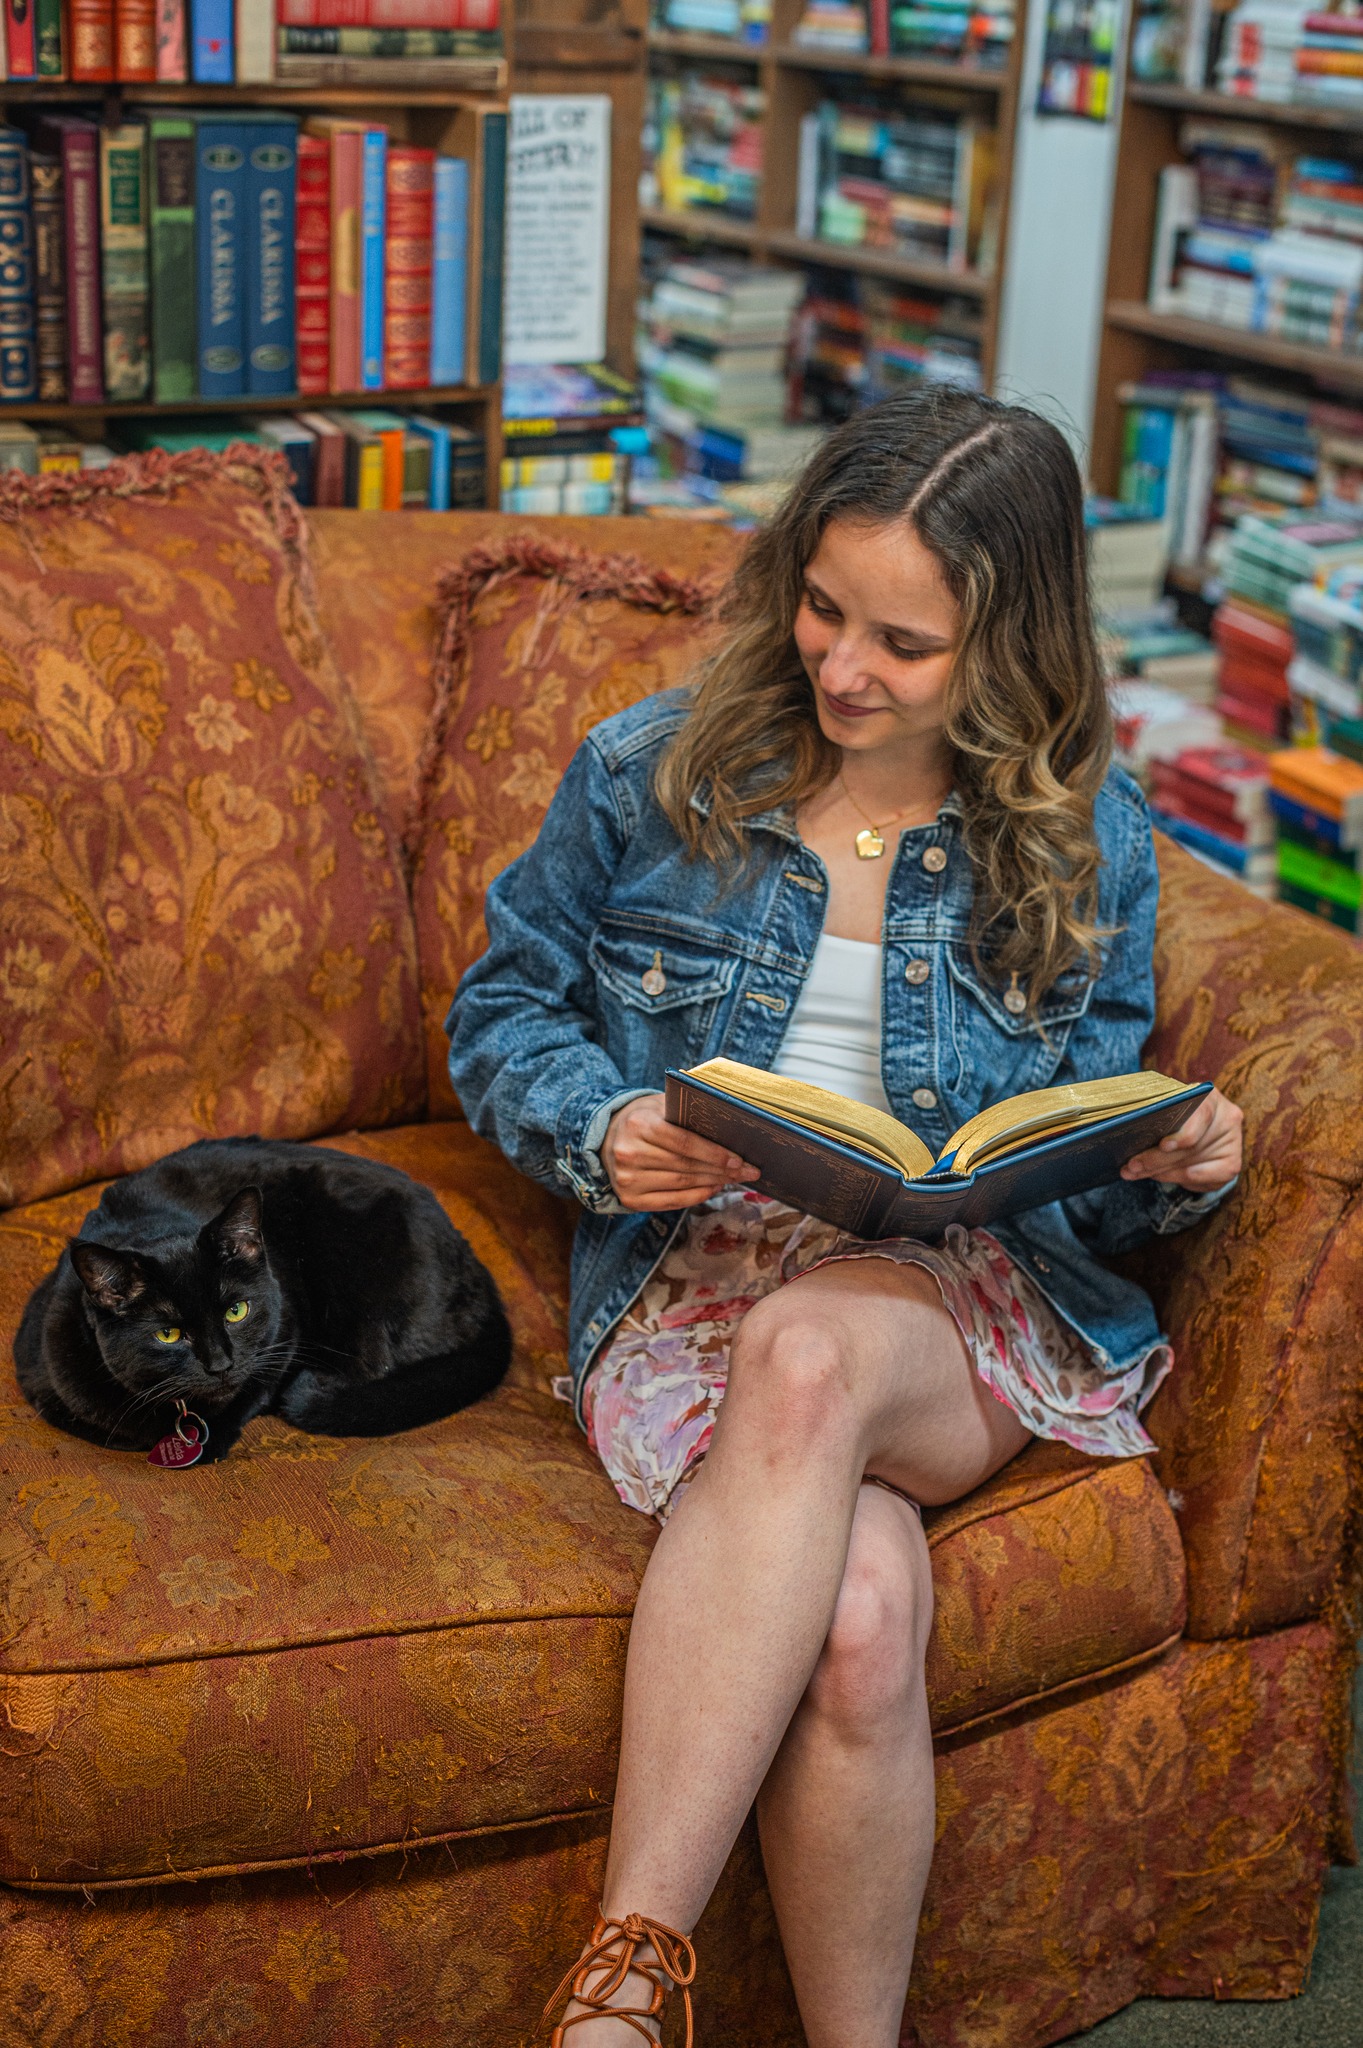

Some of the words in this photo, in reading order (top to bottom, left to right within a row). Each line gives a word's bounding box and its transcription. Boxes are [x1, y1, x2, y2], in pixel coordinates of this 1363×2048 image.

[210, 188, 235, 326] CLARISSA
[259, 188, 284, 326] CLARISSA
[172, 1437, 184, 1461] Zelda
